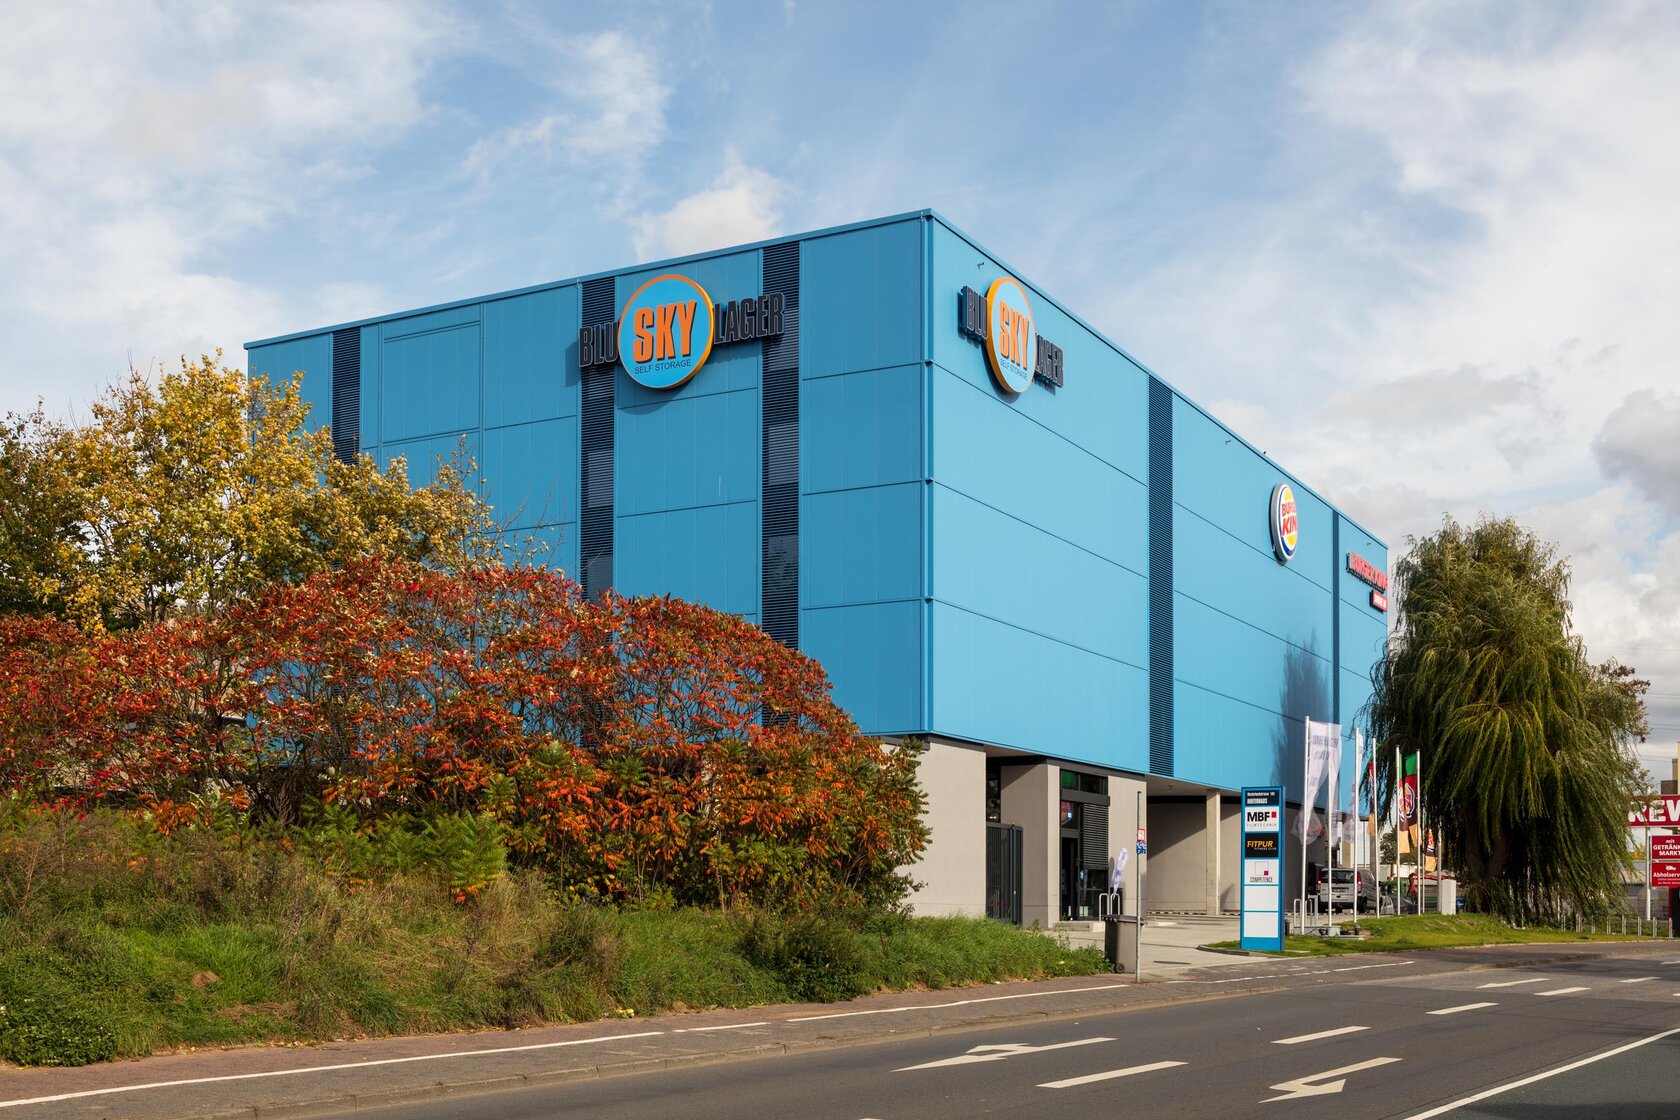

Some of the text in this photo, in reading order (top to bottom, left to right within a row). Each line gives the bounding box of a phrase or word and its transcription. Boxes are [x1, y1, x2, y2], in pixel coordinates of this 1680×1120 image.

[579, 292, 785, 368] BLU SKY LAGER
[999, 301, 1029, 371] SKY
[634, 359, 691, 375] SELF STORAGE
[1282, 515, 1297, 536] KIN
[1247, 812, 1270, 822] MBF
[1247, 840, 1274, 848] FITPUR
